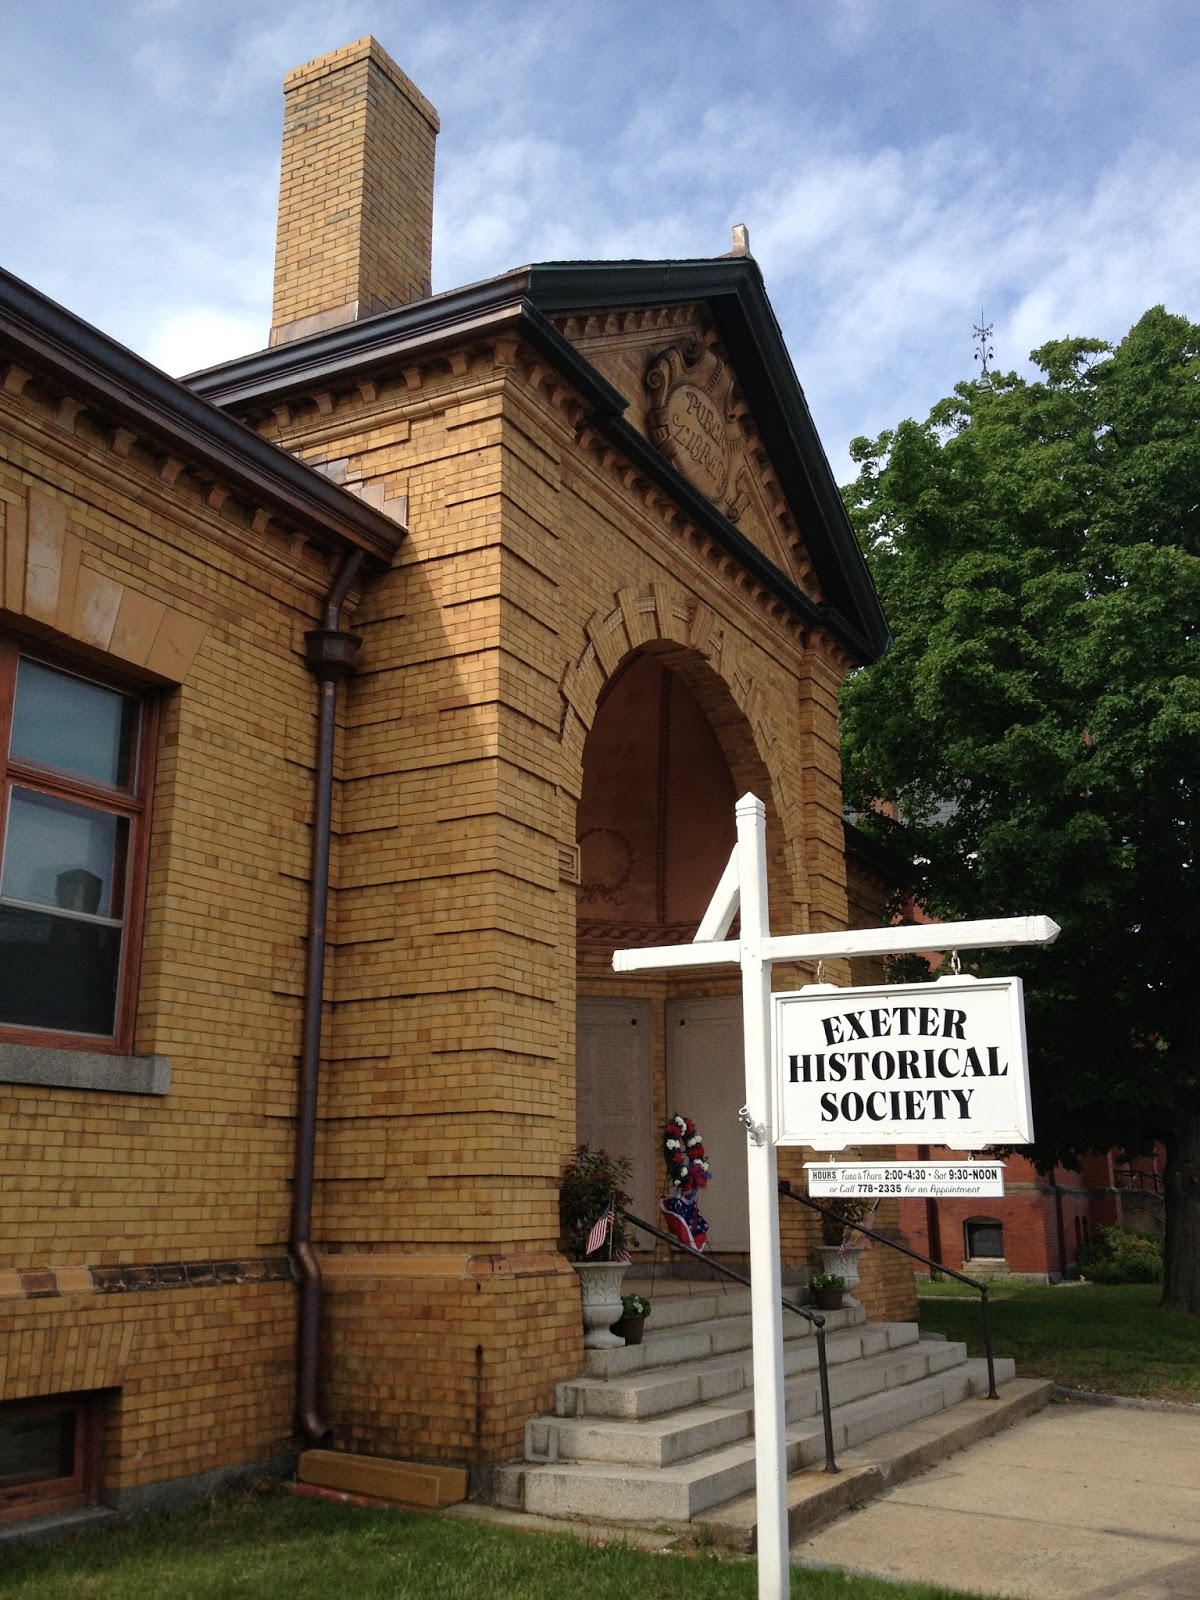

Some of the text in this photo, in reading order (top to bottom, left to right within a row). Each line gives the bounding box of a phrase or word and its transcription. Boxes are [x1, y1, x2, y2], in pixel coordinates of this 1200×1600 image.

[821, 1007, 967, 1046] EXETER
[788, 1046, 1008, 1083] HISTORICAL
[820, 1089, 975, 1122] SOCIETY
[812, 1171, 837, 1180] HOURS
[885, 1169, 926, 1180] 2:00-4:30
[934, 1169, 947, 1180] Sat
[948, 1169, 997, 1180] 9:30-NOON
[840, 1184, 855, 1193] Call
[857, 1184, 902, 1193] 778-2335
[904, 1184, 917, 1193] for
[930, 1184, 980, 1196] Appointment
